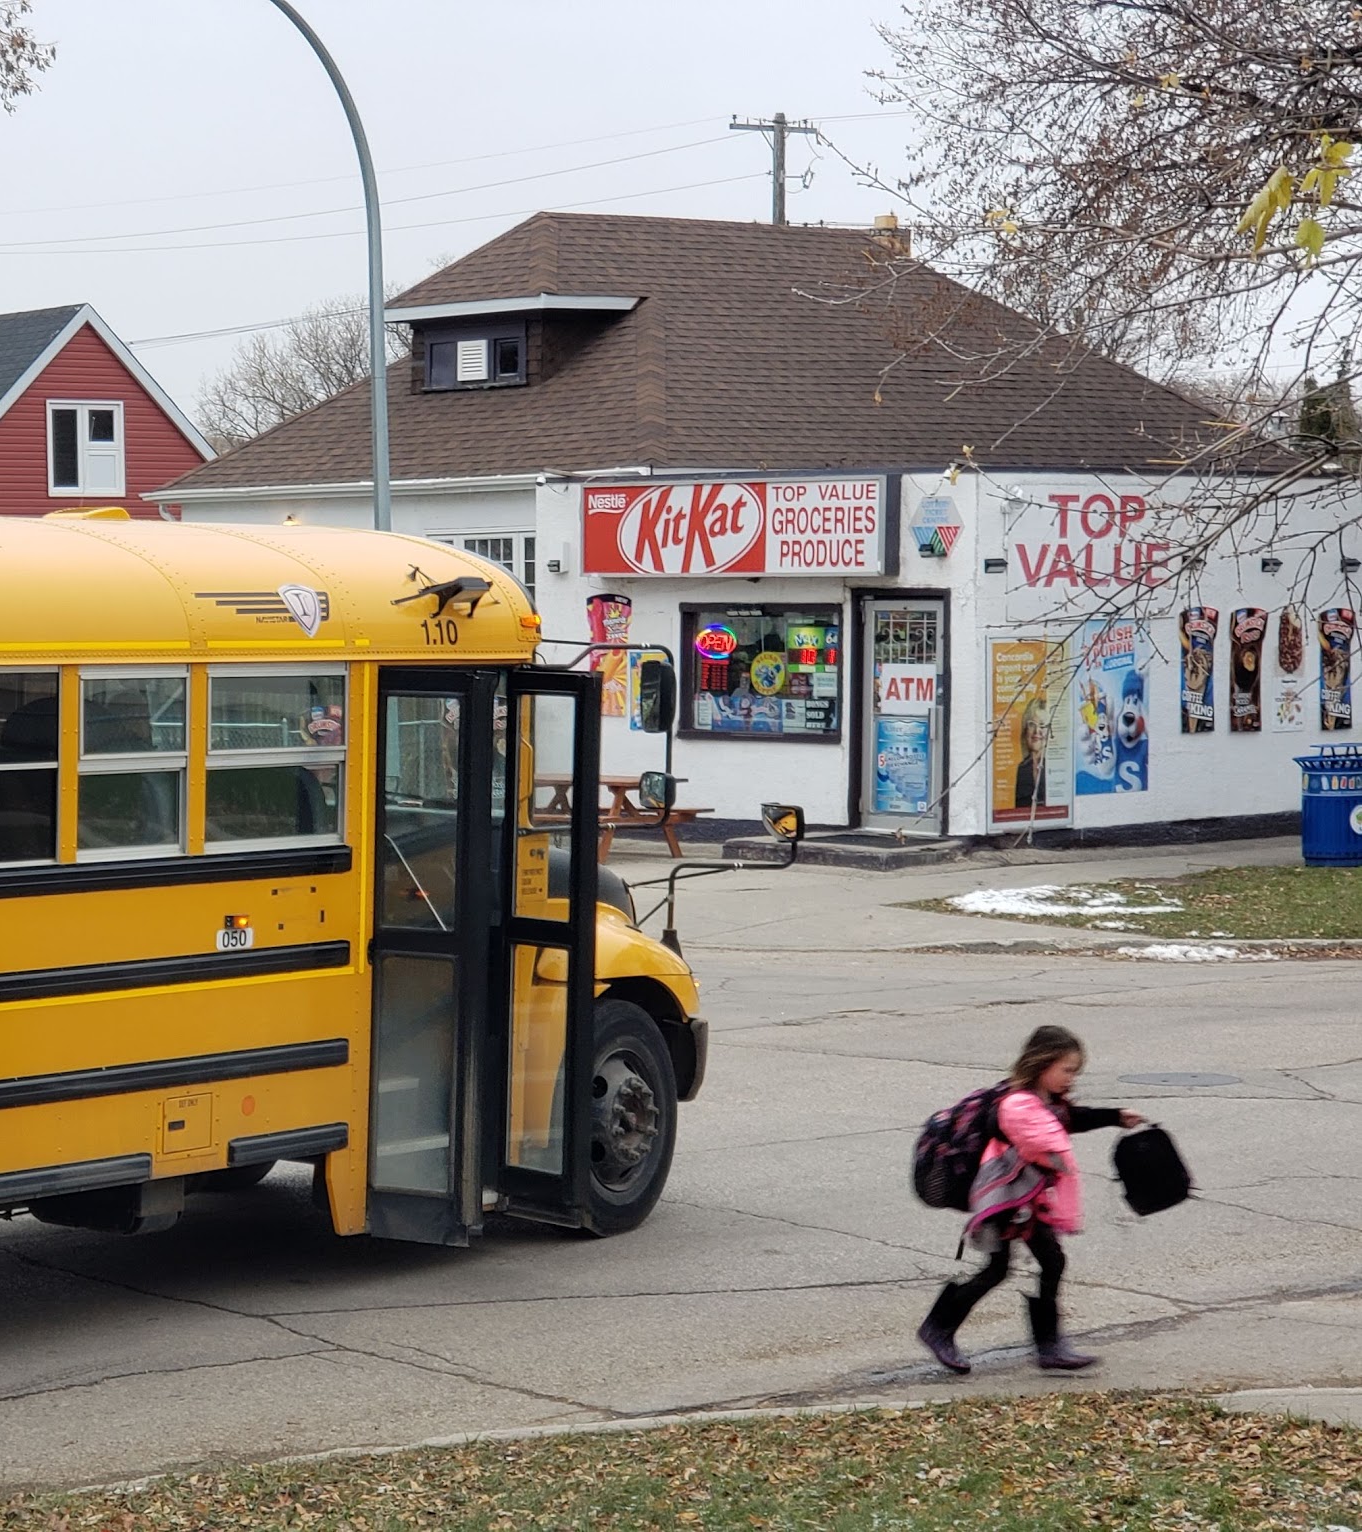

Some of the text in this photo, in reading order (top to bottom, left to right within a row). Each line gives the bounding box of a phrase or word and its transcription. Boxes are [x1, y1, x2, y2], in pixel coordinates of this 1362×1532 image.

[772, 483, 877, 502] TOP VALUE
[635, 484, 747, 574] KitKat
[772, 506, 876, 535] GROCERIES
[1048, 493, 1146, 540] TOP
[780, 539, 865, 567] PRODUCE
[1015, 543, 1171, 588] VALUE
[420, 619, 459, 646] 1.10
[699, 633, 734, 653] OPEN
[885, 677, 934, 701] ATM
[806, 711, 825, 719] SOLD
[222, 929, 247, 948] 050
